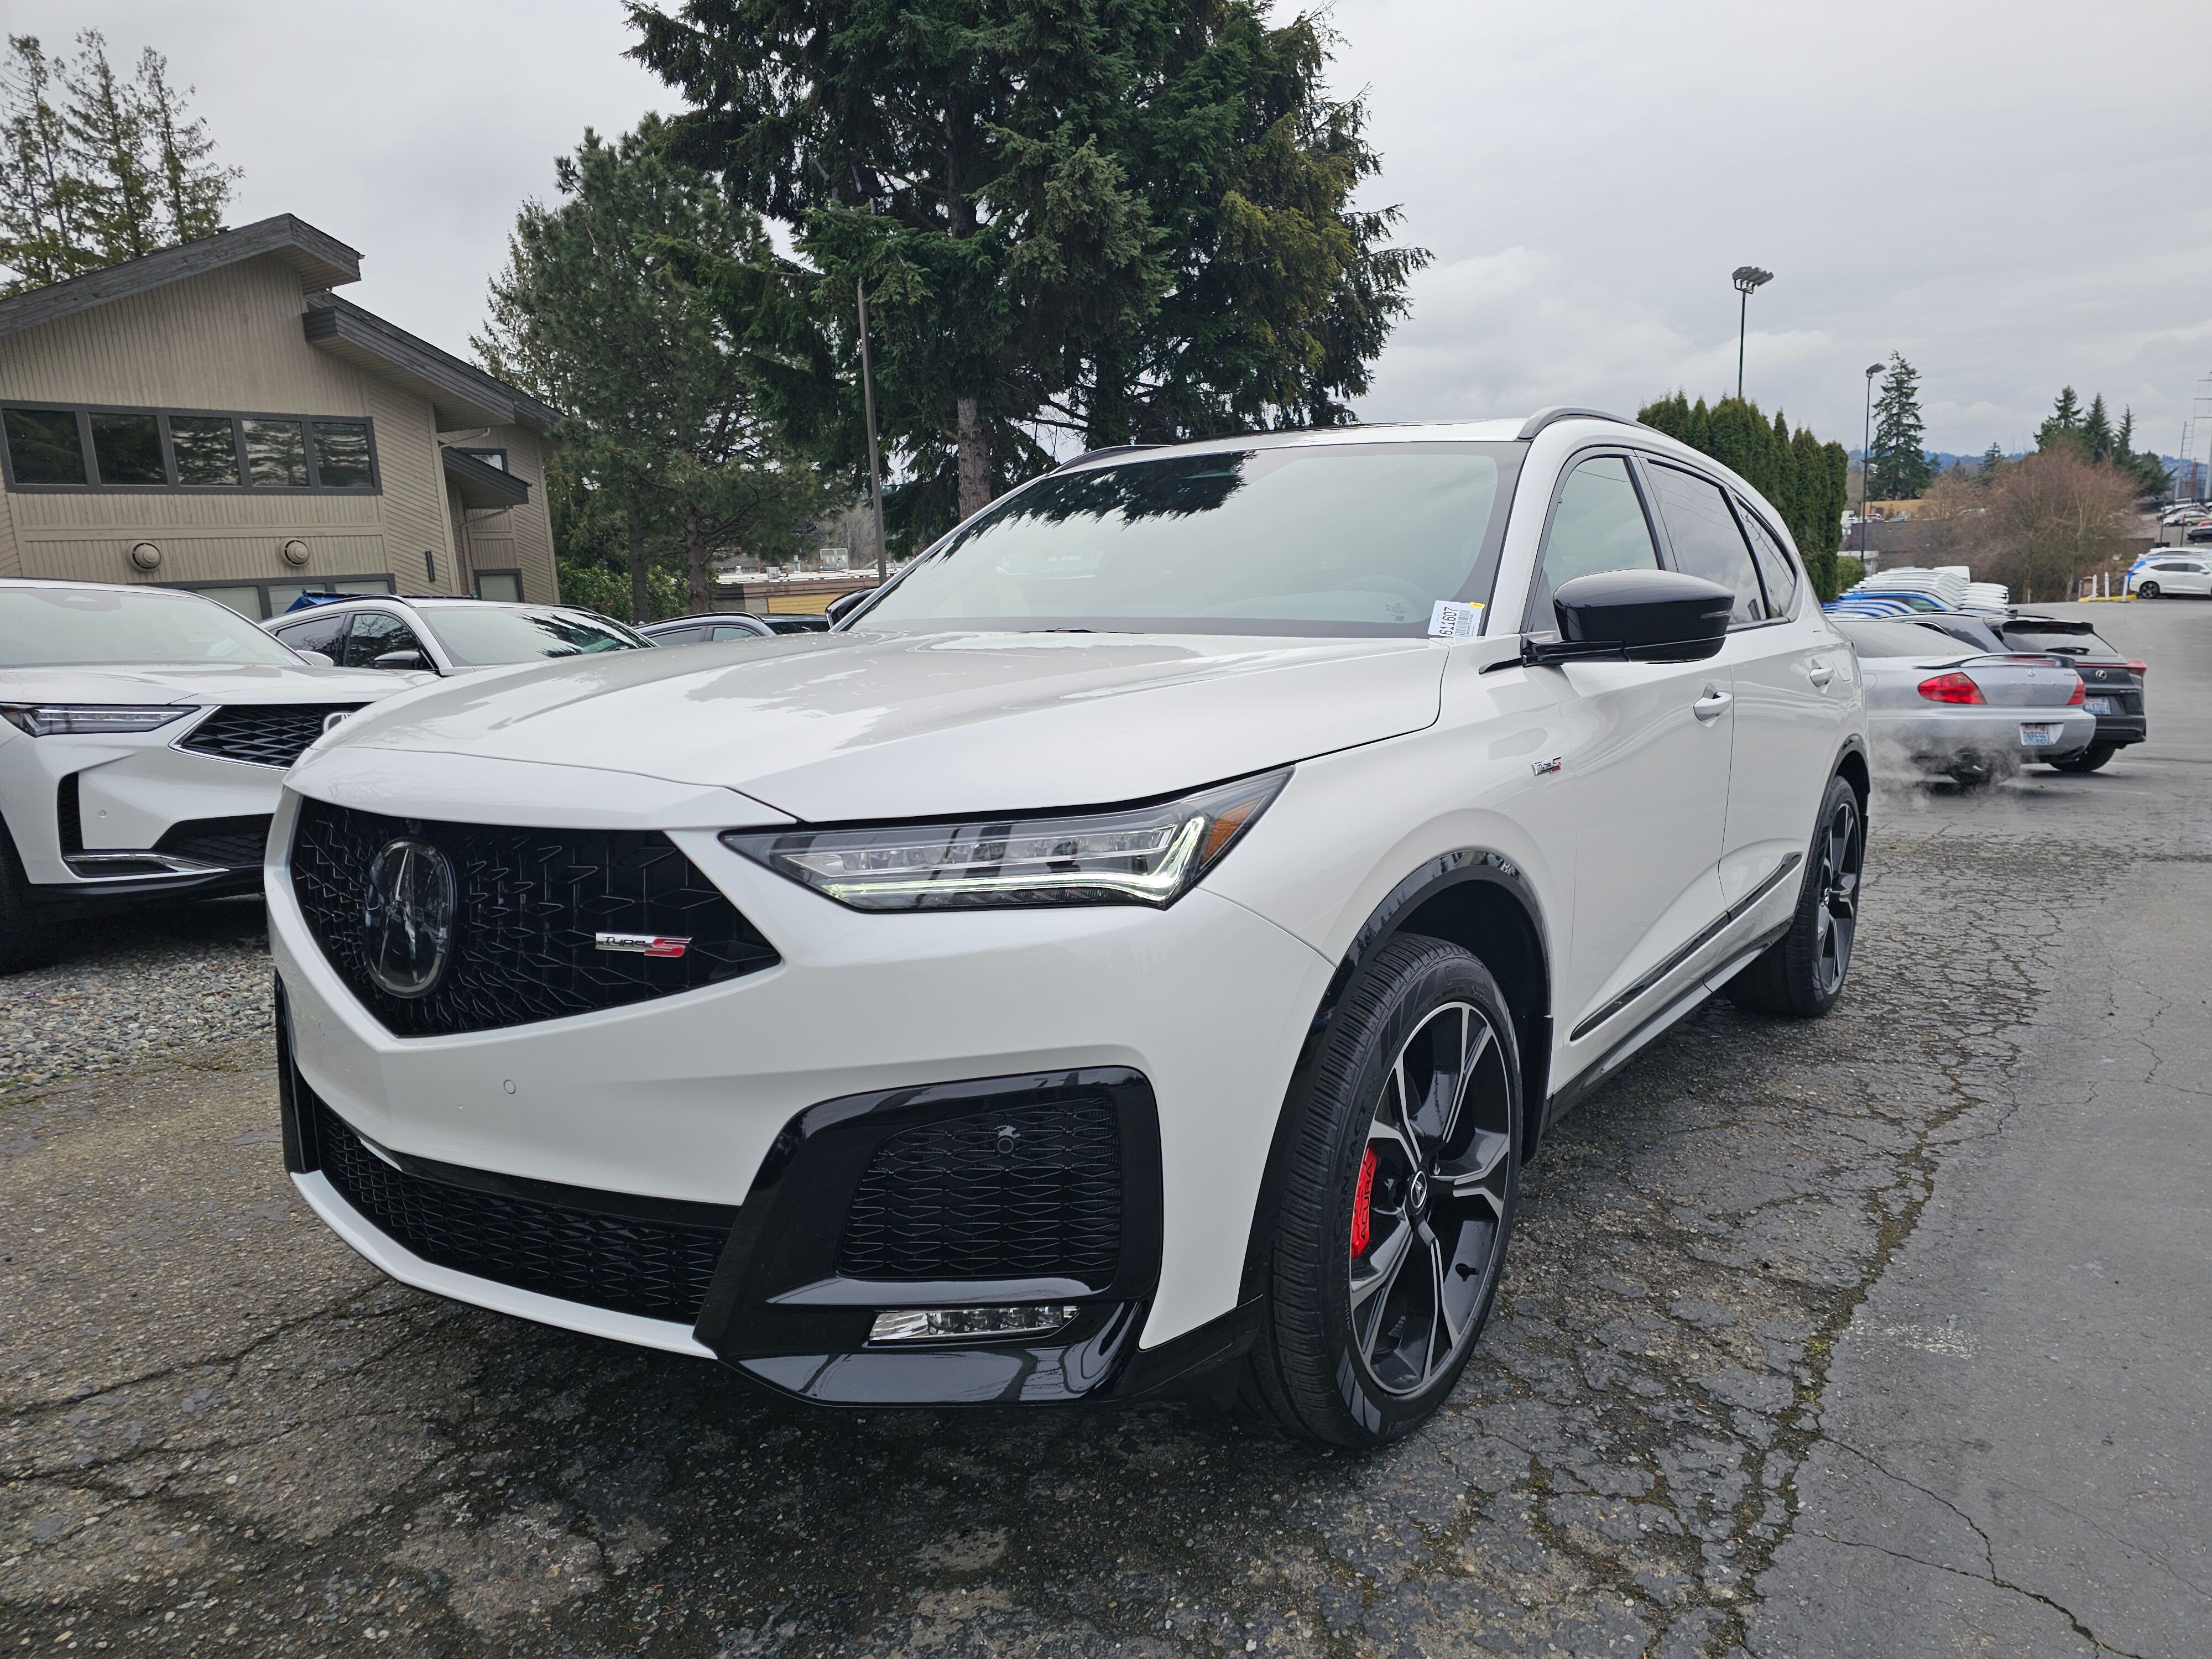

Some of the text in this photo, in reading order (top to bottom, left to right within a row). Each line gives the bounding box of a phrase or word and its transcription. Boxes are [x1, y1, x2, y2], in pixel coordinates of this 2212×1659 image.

[1439, 607, 1458, 635] 611607
[644, 937, 693, 958] S
[1360, 1162, 1373, 1240] ACURA
